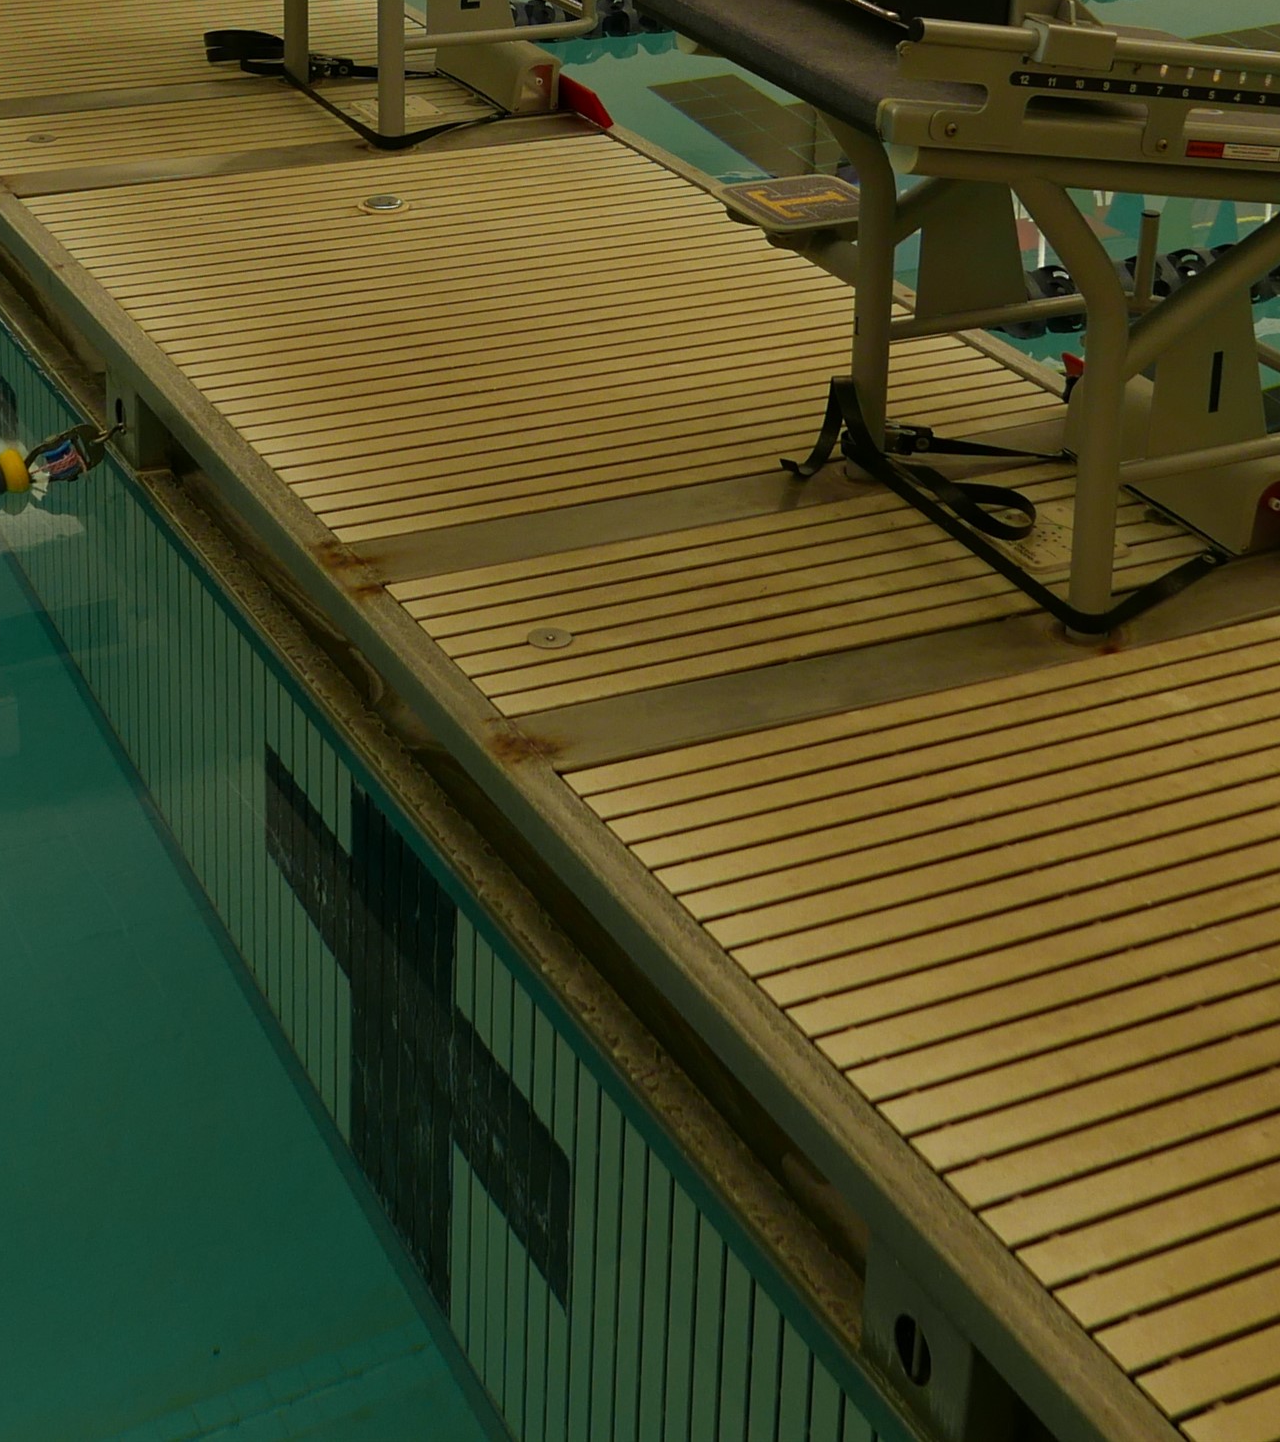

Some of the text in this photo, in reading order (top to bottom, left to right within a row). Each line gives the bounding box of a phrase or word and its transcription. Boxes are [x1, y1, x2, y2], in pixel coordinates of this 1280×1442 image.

[1019, 74, 1029, 84] 12
[1048, 77, 1057, 86] 11
[1076, 79, 1085, 89] 10
[1103, 81, 1110, 91] 9
[1129, 84, 1137, 93] 8
[1157, 86, 1164, 96] 7
[1182, 88, 1189, 98] 6
[1208, 90, 1216, 100] 5
[1233, 93, 1241, 102] 4
[1259, 95, 1266, 104] 3
[1209, 351, 1224, 413] 1
